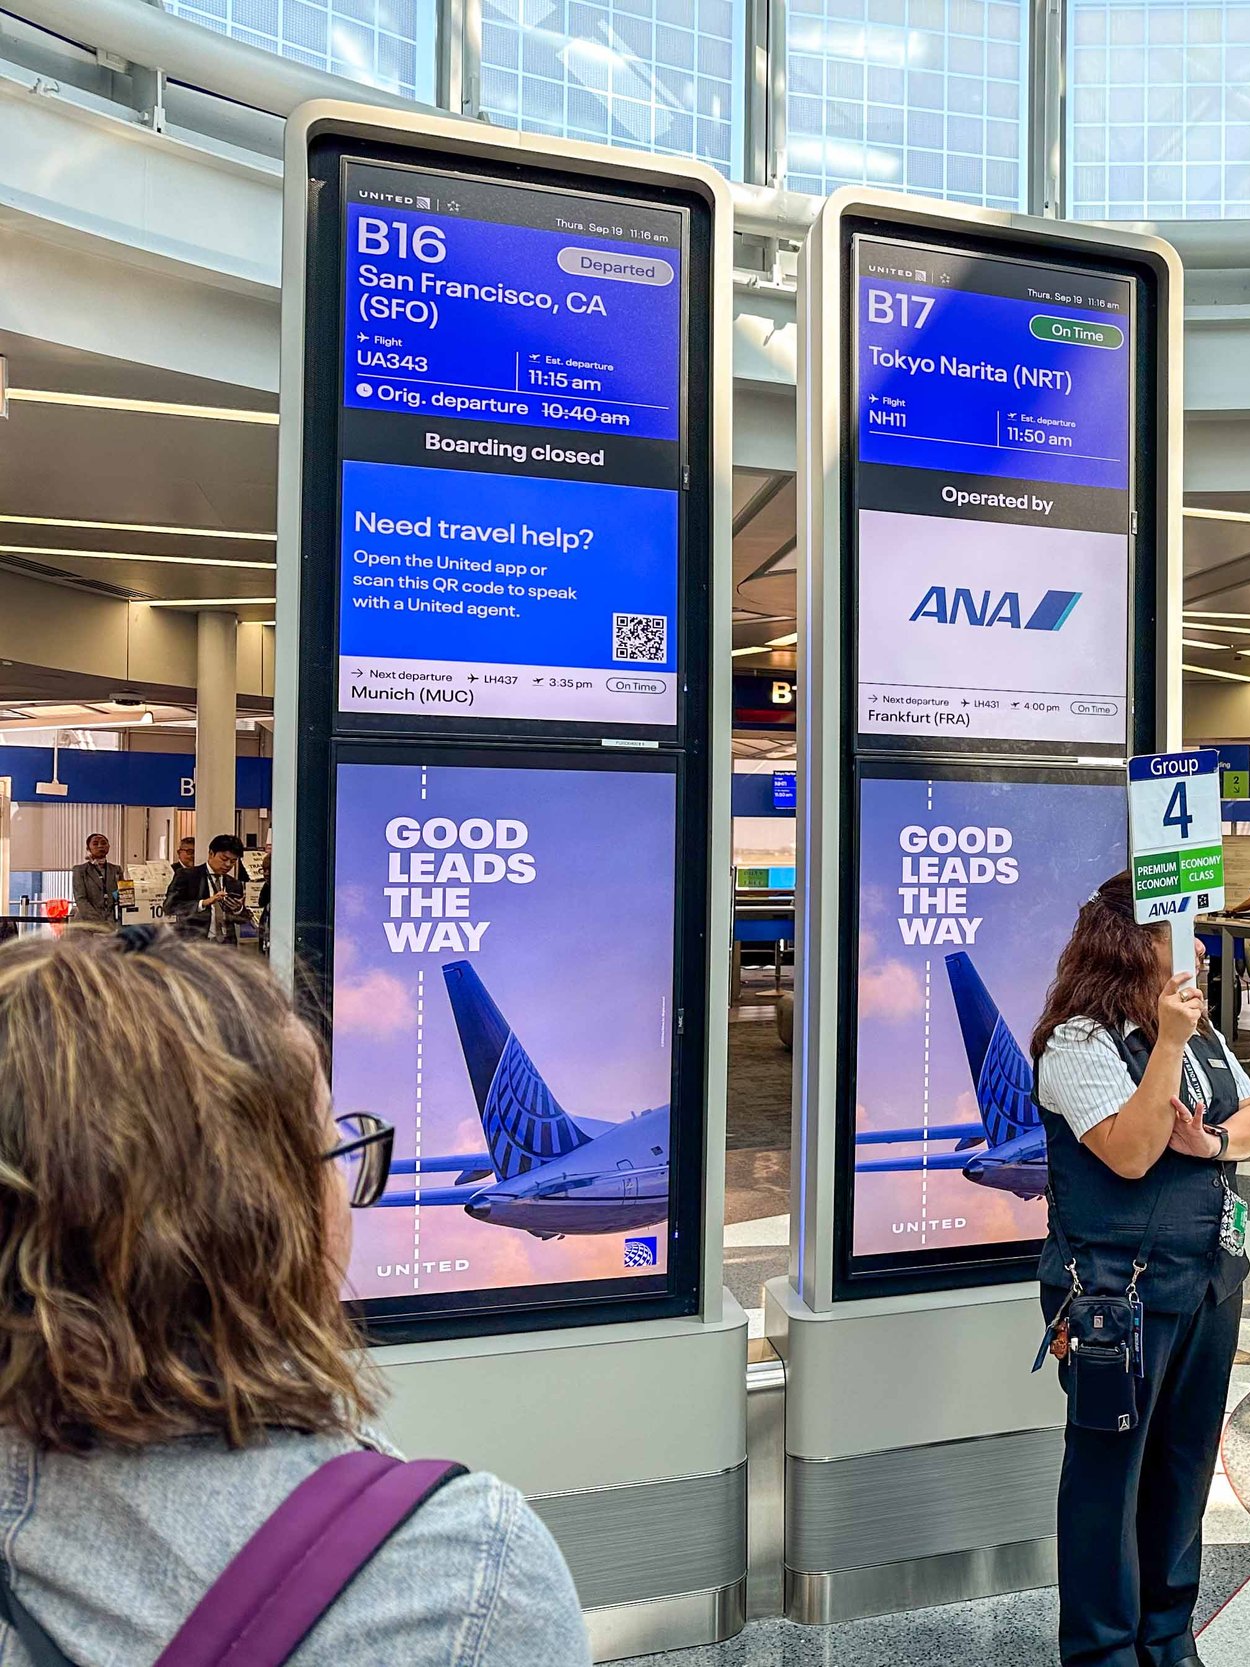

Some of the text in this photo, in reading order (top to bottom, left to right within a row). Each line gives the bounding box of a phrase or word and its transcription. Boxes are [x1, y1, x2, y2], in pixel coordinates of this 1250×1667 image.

[359, 190, 414, 205] UNITED
[357, 216, 447, 263] B16
[556, 218, 669, 242] Thurs. Sep 19 11:16 am
[580, 256, 656, 280] Departed
[868, 266, 912, 277] UNITED
[358, 264, 607, 316] San Francisco, CA
[1027, 288, 1120, 310] Thurs. Sep 19 11:16 am
[359, 292, 439, 329] (SFO)
[867, 289, 936, 329] B17
[374, 336, 403, 348] Flight
[1052, 324, 1104, 342] On Time
[357, 350, 428, 372] UA343
[545, 355, 614, 372] Est. departure
[868, 345, 1073, 396] Tokyo Narita (NRT)
[528, 369, 602, 392] 11:15 am
[378, 386, 631, 427] Orig. departure 10:40 am
[882, 396, 906, 408] Flight
[869, 410, 907, 428] NH11
[1020, 413, 1076, 428] Est. departure
[1007, 426, 1073, 448] 11:50 am
[425, 432, 605, 466] Boarding closed
[941, 486, 1054, 514] Operated by
[354, 510, 594, 554] Need travel help?
[354, 550, 547, 578] Open the United app or
[352, 574, 578, 602] scan this QR code to speak
[352, 596, 520, 620] with a United agent.
[909, 586, 1021, 629] ANA
[370, 668, 593, 690] Next departure LH437 3:35 pm
[615, 680, 657, 692] On Time
[351, 685, 475, 706] Munich (MUC)
[882, 695, 904, 705] Next
[905, 696, 950, 708] departure
[974, 700, 1000, 709] LH431
[1046, 704, 1060, 712] pm
[868, 710, 970, 728] Frankfurt (FRA)
[1078, 704, 1111, 714] On Time
[1150, 757, 1199, 776] Group
[1233, 776, 1240, 784] 2
[1162, 781, 1193, 840] 4
[384, 816, 529, 850] GOOD
[899, 825, 1013, 854] GOOD
[388, 852, 537, 884] LEADS
[902, 856, 1020, 885] LEADS
[1137, 862, 1177, 877] PREMIUM
[1180, 855, 1221, 870] ECONOMY
[1136, 876, 1179, 892] ECONOMY
[1188, 870, 1214, 883] CLASS
[384, 887, 470, 918] THE
[898, 887, 967, 915] THE
[1148, 900, 1178, 918] ANA
[382, 921, 491, 953] WAY
[898, 917, 984, 946] WAY
[892, 1217, 968, 1234] UNITED
[376, 1259, 470, 1278] UNITED
